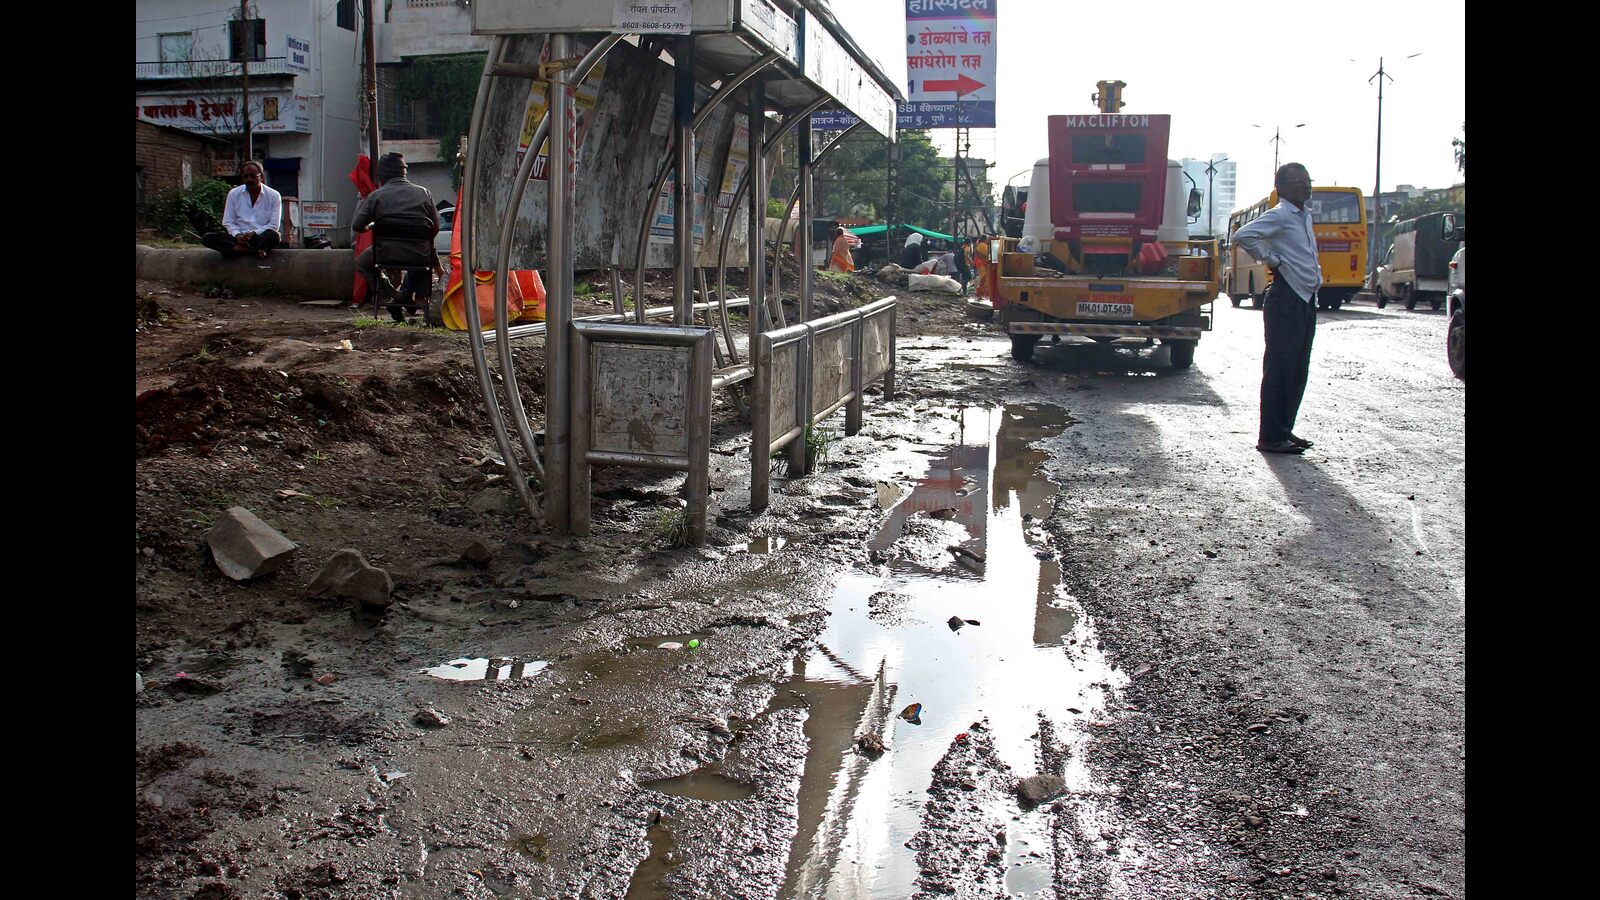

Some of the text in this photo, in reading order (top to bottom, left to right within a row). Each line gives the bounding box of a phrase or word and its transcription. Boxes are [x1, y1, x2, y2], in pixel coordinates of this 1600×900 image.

[919, 26, 991, 46] डोळ्यांचे तज्ञ
[961, 55, 982, 71] तज्ञ
[898, 104, 916, 113] SBI
[931, 112, 944, 126] पुणे
[1066, 115, 1149, 128] MACLIFTON
